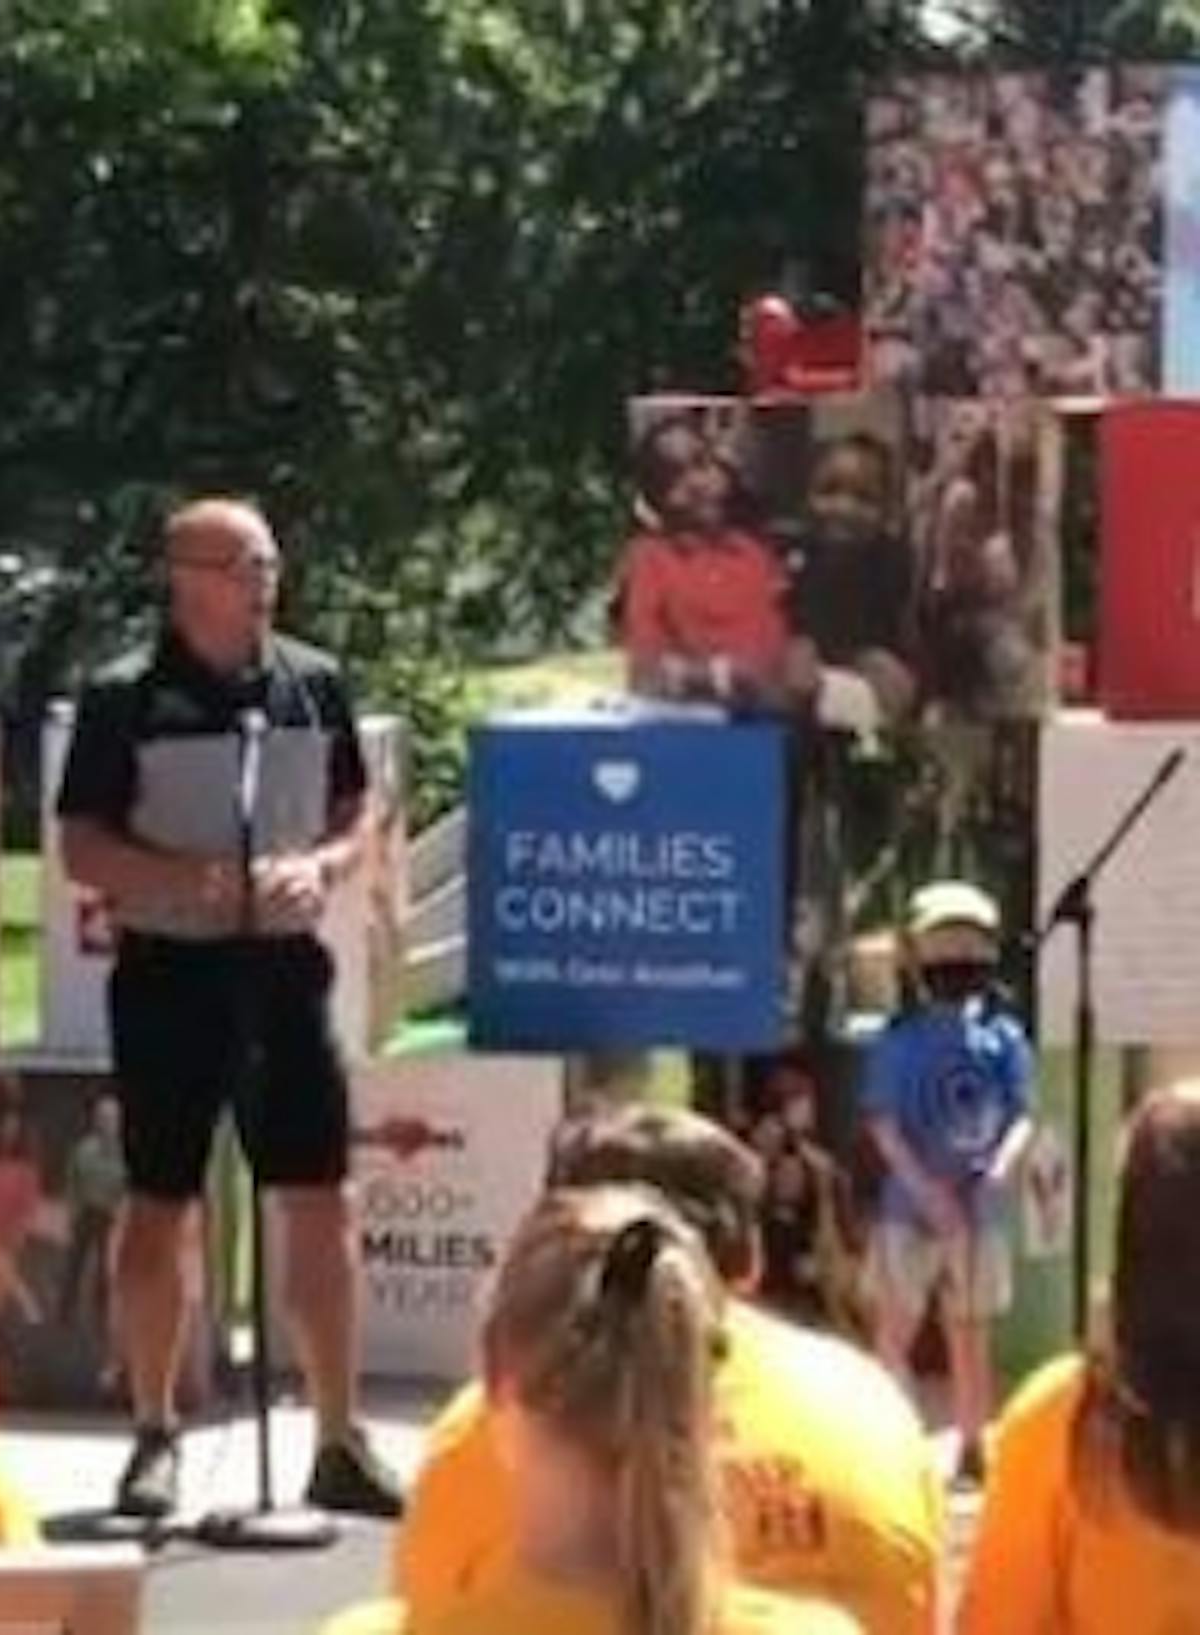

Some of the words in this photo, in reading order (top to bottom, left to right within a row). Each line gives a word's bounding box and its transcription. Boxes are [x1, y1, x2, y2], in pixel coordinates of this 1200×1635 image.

[505, 832, 736, 878] FAMILIES
[495, 886, 741, 934] CONNECT
[361, 1229, 496, 1267] MILIES
